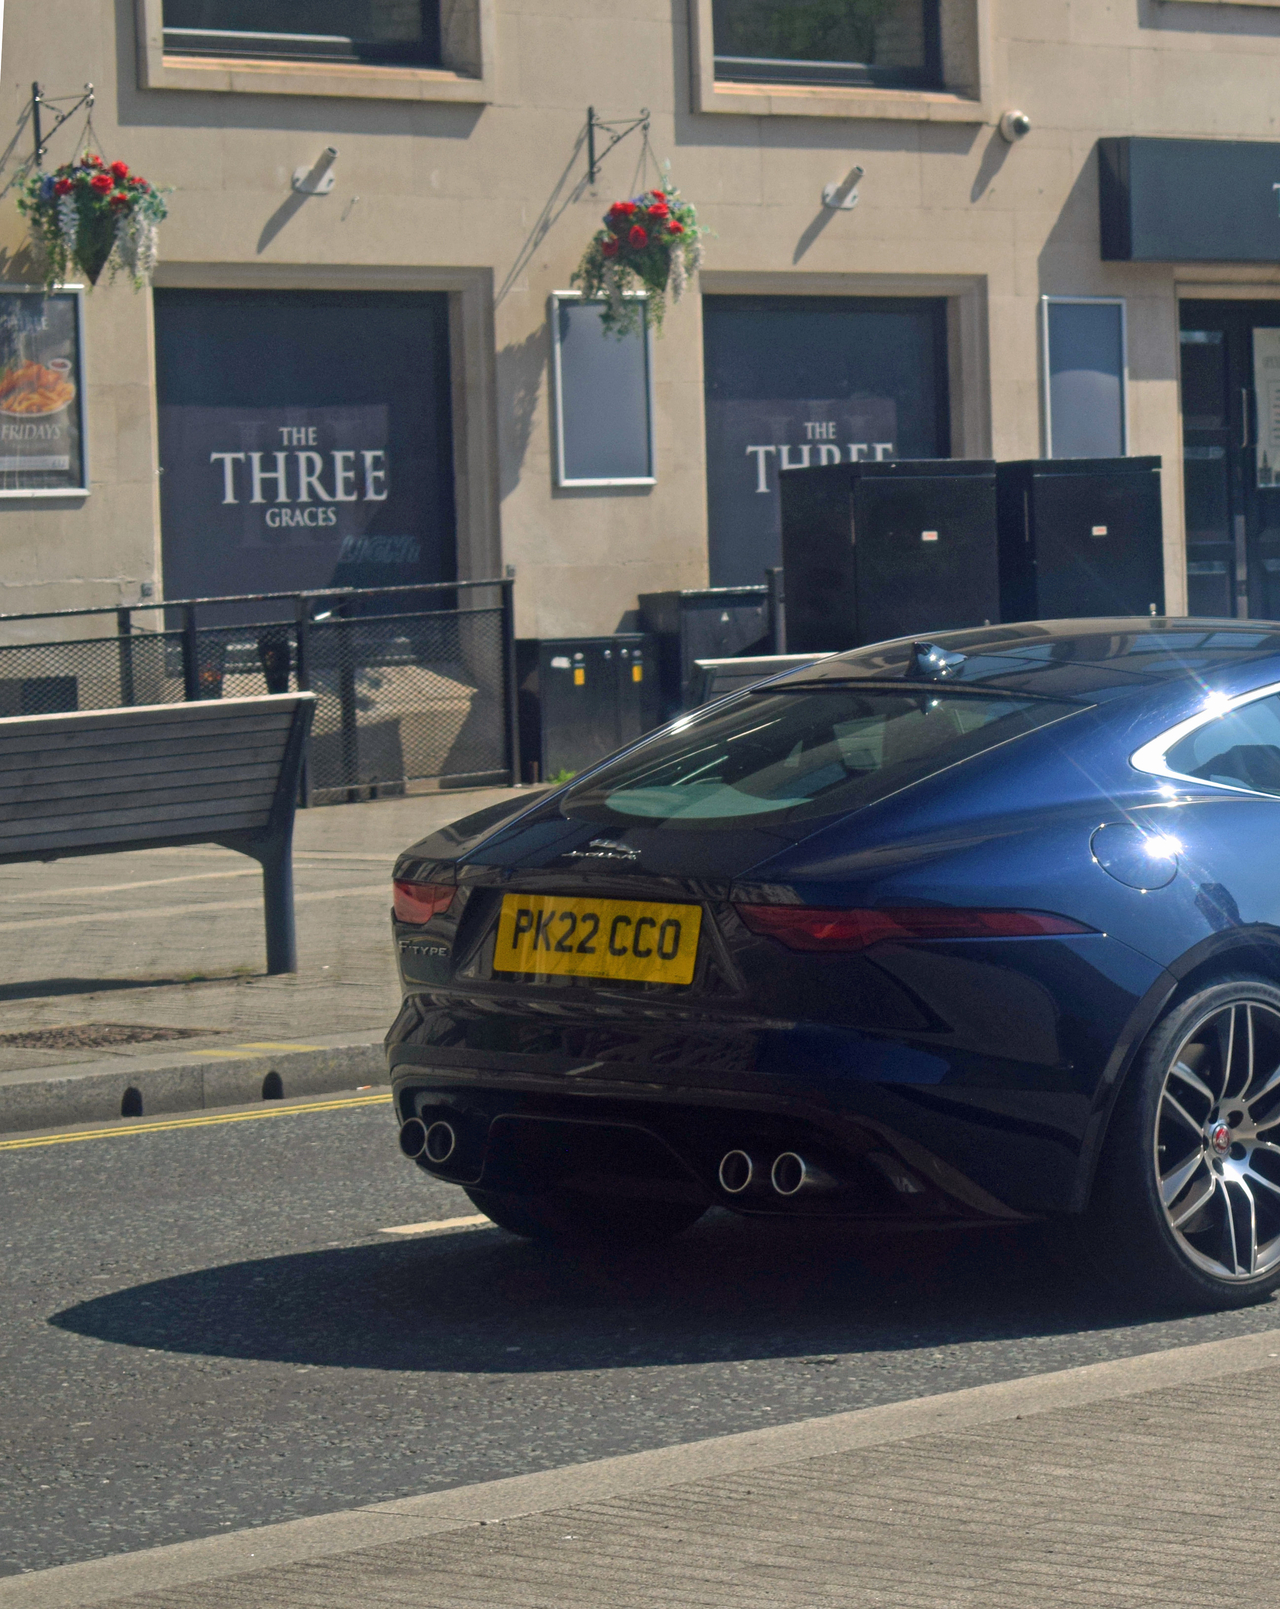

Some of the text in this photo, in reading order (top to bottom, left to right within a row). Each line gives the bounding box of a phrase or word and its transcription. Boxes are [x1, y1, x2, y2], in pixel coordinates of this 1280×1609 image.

[1, 424, 61, 440] FRIDAYS
[278, 426, 318, 446] THE
[804, 421, 837, 440] THE
[210, 450, 388, 504] THREE
[265, 507, 337, 528] GRACES
[511, 908, 682, 960] PK22 CCO
